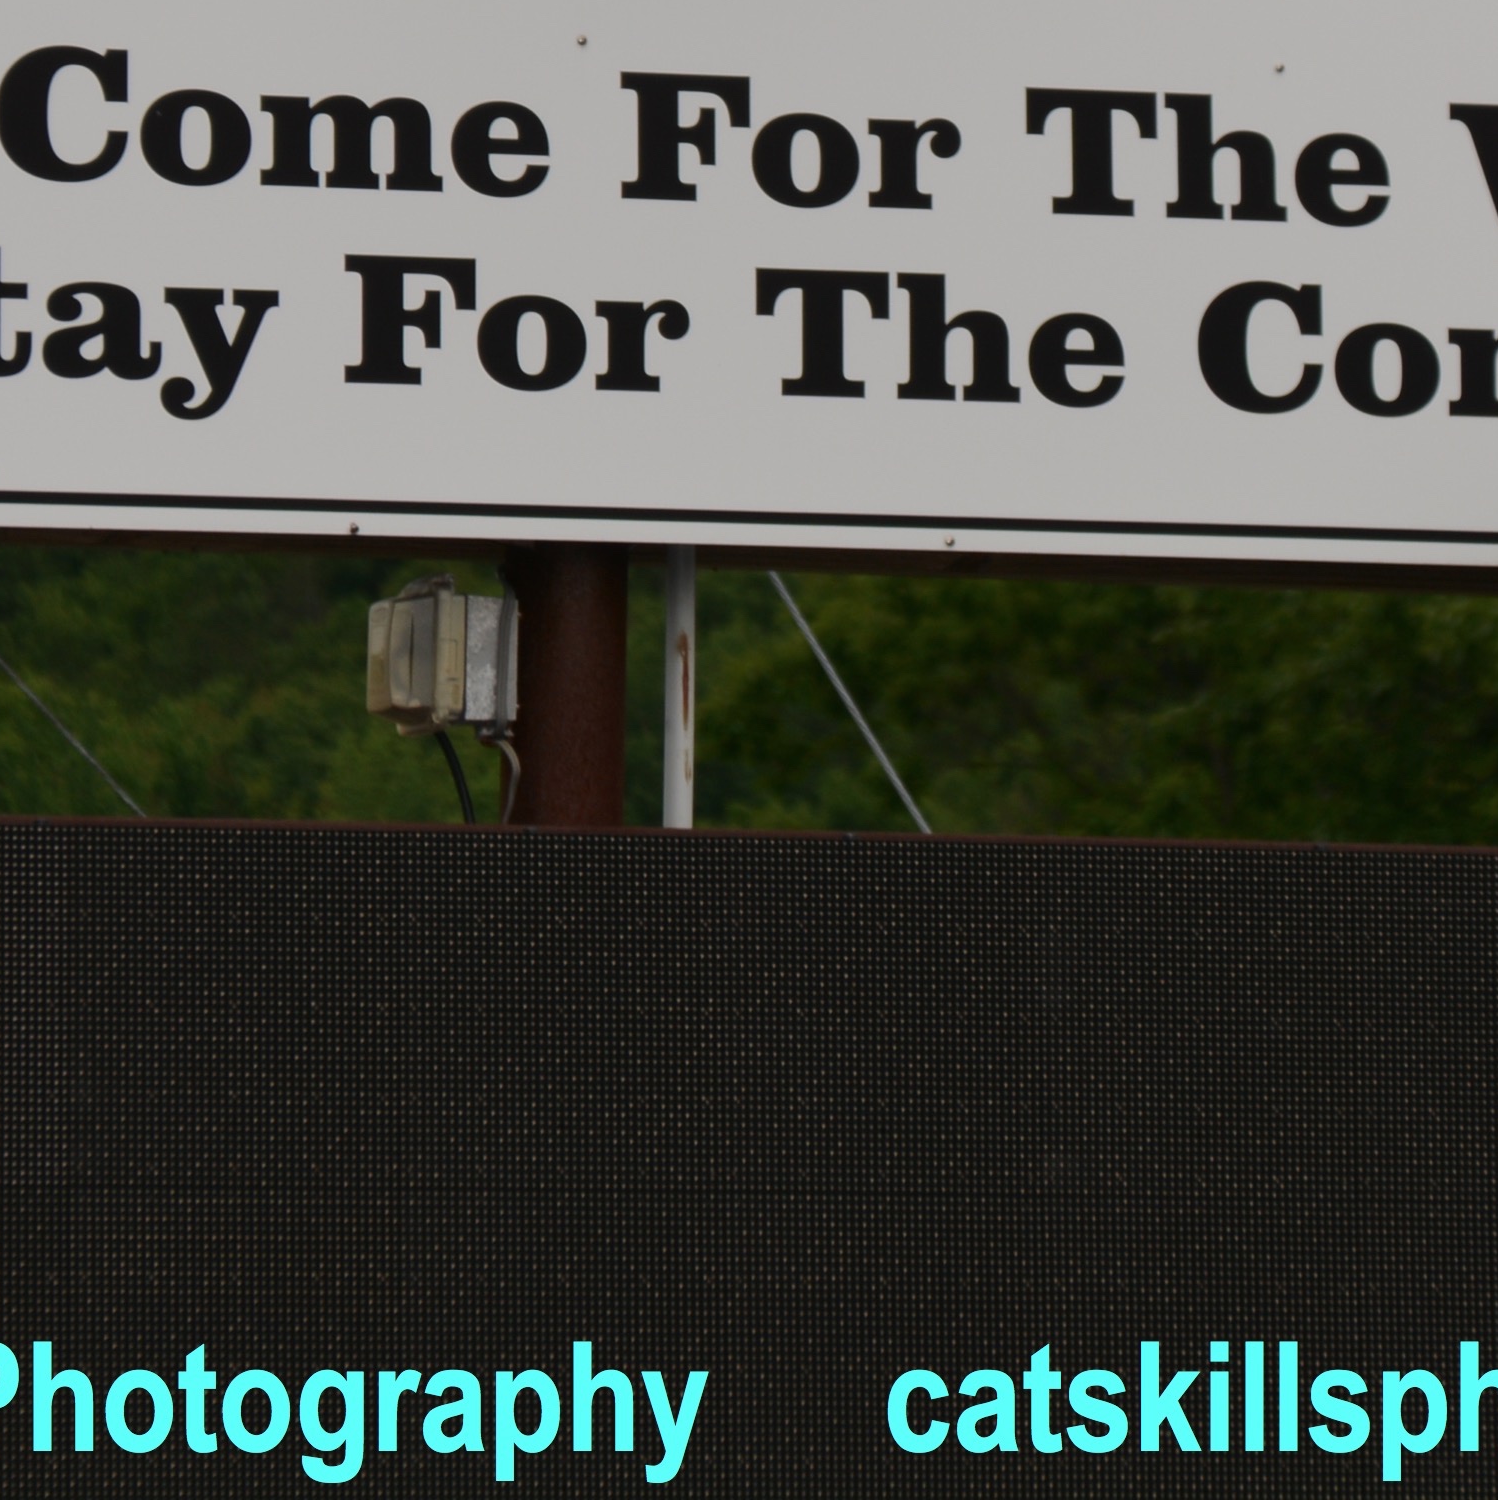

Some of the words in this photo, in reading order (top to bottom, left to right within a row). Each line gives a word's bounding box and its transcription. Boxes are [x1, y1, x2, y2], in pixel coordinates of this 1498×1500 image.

[621, 72, 961, 210] For
[1026, 87, 1389, 227] The
[345, 254, 690, 392] For
[756, 268, 1124, 408] The
